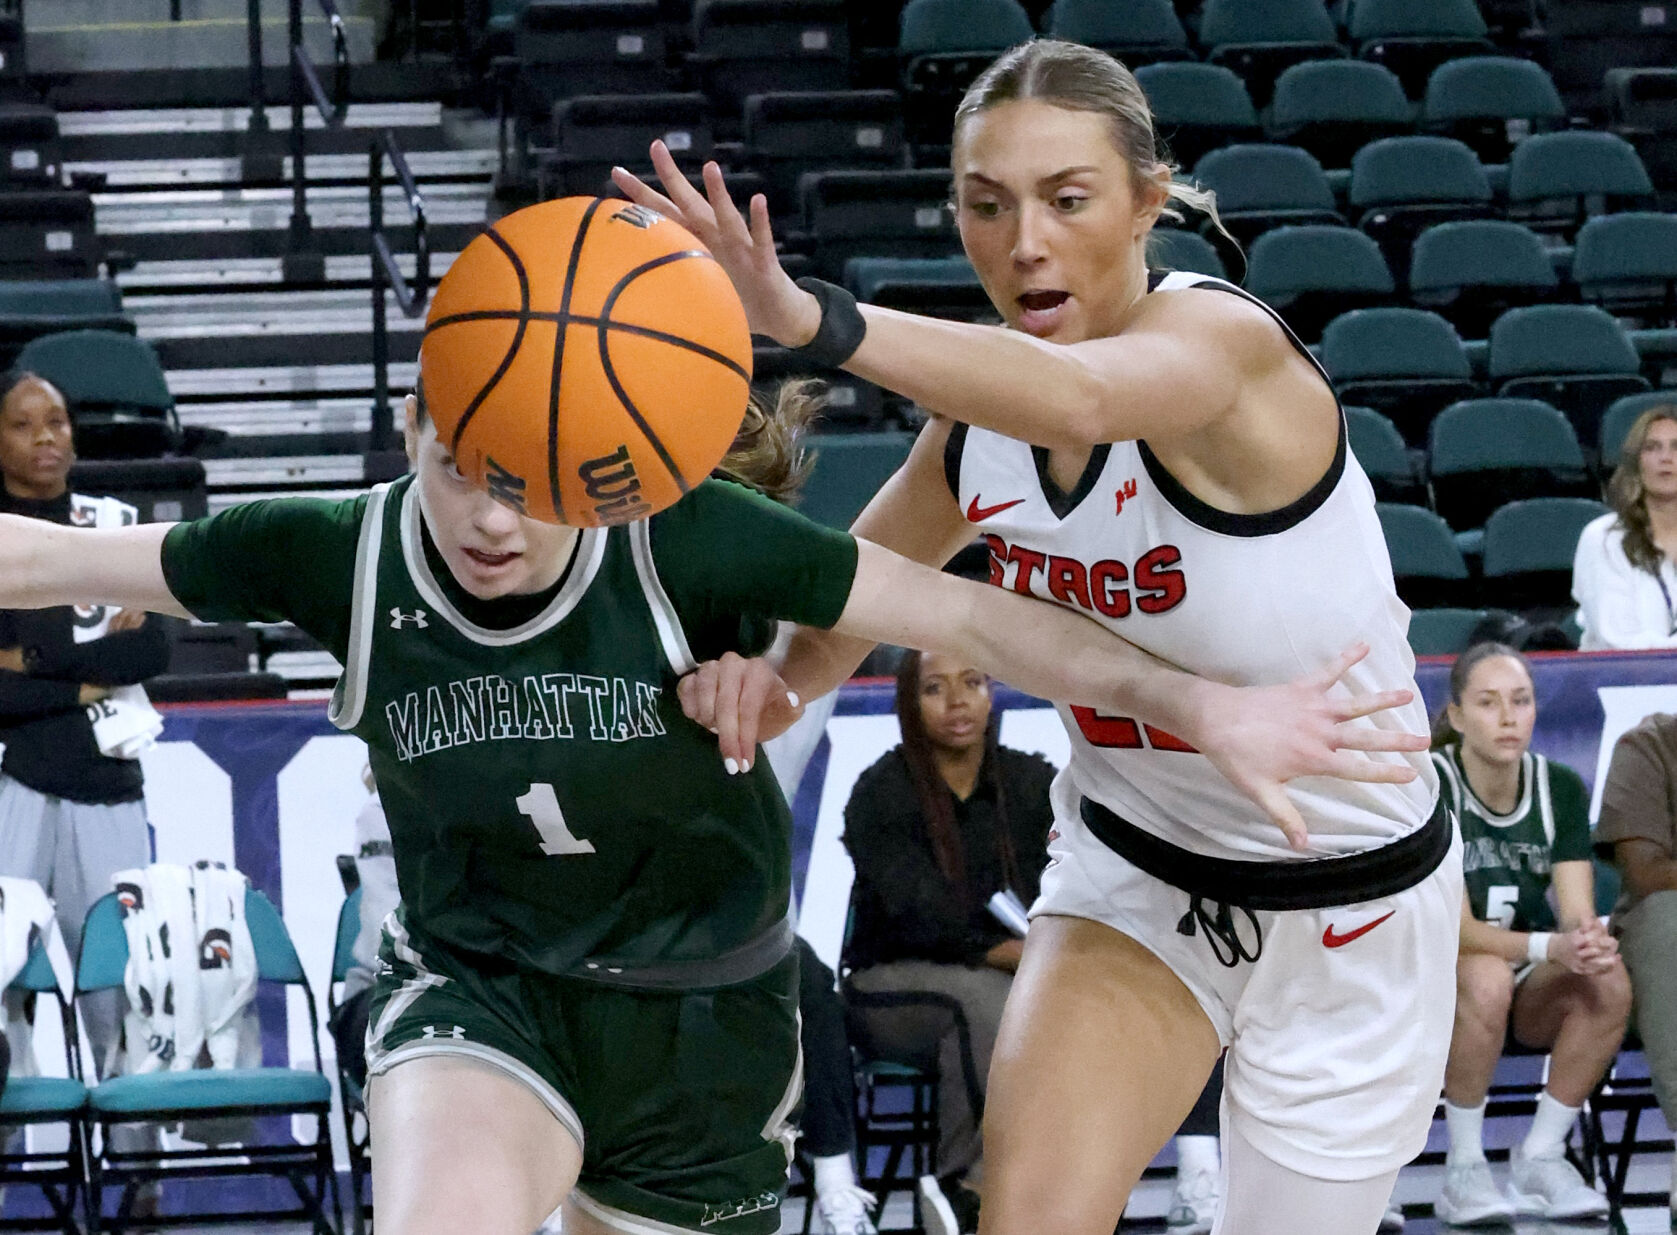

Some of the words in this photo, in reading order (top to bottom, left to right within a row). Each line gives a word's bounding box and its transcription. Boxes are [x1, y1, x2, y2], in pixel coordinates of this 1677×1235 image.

[385, 673, 667, 764] MANHATTAN
[515, 782, 597, 856] 1
[1486, 885, 1520, 931] 5
